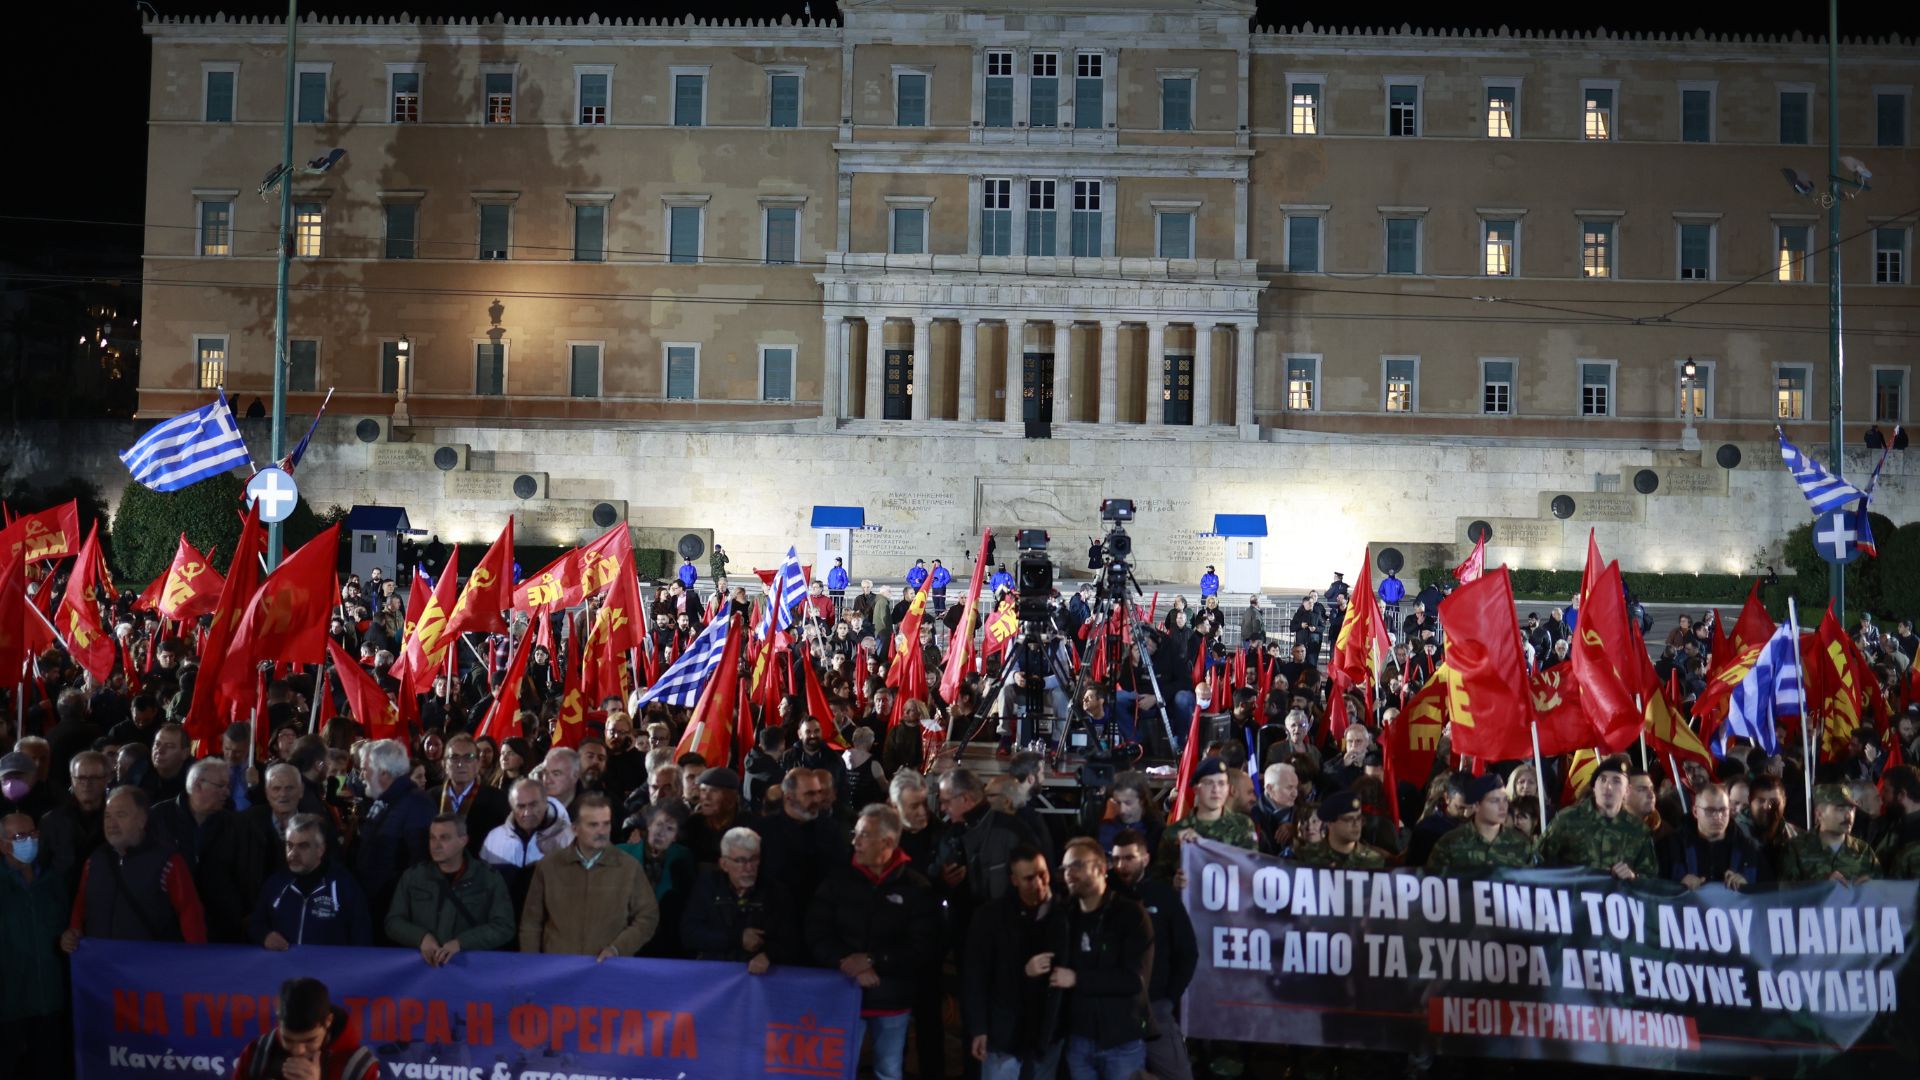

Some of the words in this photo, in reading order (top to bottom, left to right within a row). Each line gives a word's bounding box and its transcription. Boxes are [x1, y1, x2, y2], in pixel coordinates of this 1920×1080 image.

[1201, 863, 1240, 912] ΟΙ
[1252, 866, 1462, 925] ΦΑΝΤΑΡΟΙ
[1473, 880, 1573, 936] ΕΙΝΑΙ
[1581, 891, 1646, 943] ΤΟΥ
[1658, 904, 1754, 955] ΛΑΟΥ
[1767, 906, 1905, 956] ΠΑΙΔΙΑ
[1212, 925, 1272, 971] ΕΞΩ
[1282, 930, 1353, 977] ΑΠΟ
[1363, 933, 1409, 979] ΤΑ
[1418, 936, 1552, 987] ΣΥΝΟΡΑ
[1561, 948, 1625, 994] ΔΕΝ
[1630, 956, 1752, 1009] ΕΧΟΥΝΕ
[1758, 968, 1897, 1013] ΔΟΥΛΕΙΑ
[112, 989, 169, 1036] ΝΑ
[183, 992, 283, 1038] ΓΥΡΙ
[343, 997, 452, 1045] ΤΩΡΑ
[467, 1003, 494, 1047] Η
[507, 1004, 699, 1059] ΦΡΕΓΑΤΑ
[765, 1029, 846, 1070] ΚΚΕ
[1443, 996, 1502, 1036] ΝΕΟΙ
[1509, 1000, 1690, 1051] ΣΤΡΑΤΕΥΜΕΝΟΙ
[109, 1045, 226, 1077] Κανένας
